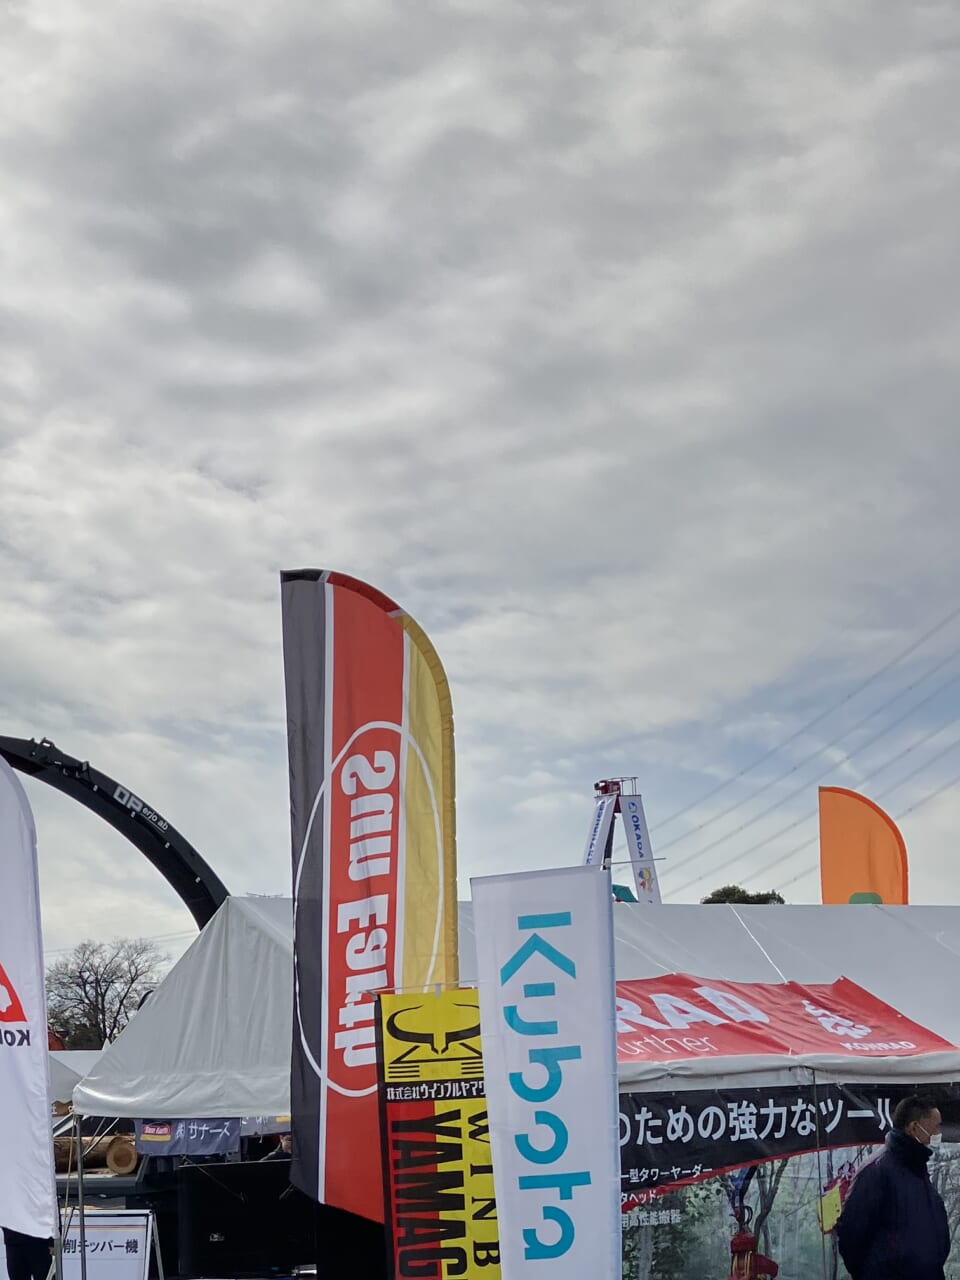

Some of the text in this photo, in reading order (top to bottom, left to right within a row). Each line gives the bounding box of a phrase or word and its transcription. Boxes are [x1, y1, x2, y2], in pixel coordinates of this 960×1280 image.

[631, 814, 645, 858] OKADA
[617, 1034, 719, 1055] urther
[500, 911, 592, 1260] Kubota
